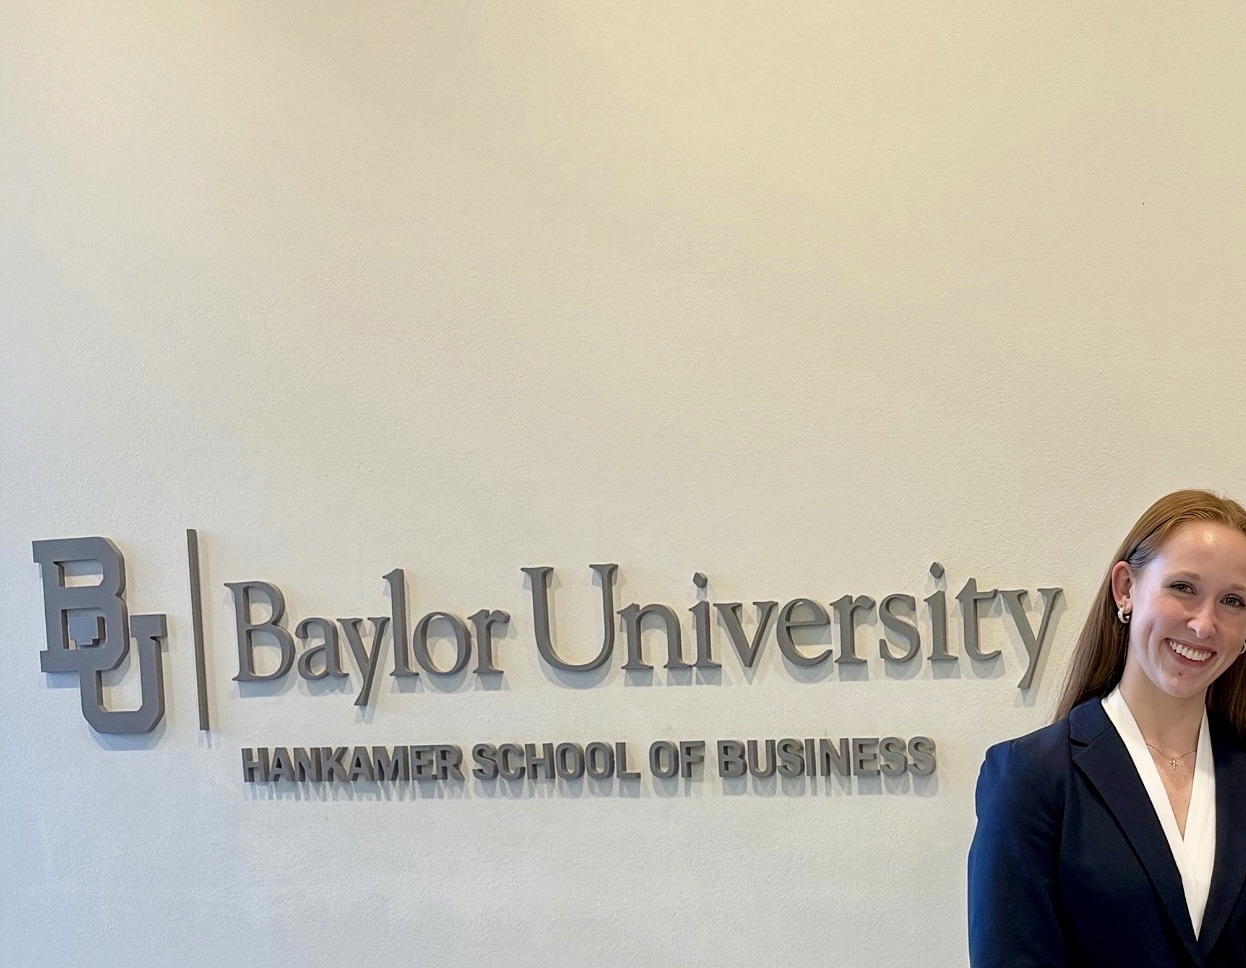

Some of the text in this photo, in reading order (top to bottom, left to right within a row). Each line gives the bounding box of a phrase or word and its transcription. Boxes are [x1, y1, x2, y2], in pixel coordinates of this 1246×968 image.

[32, 536, 168, 734] BU
[224, 561, 1064, 706] Baylor University
[241, 736, 938, 783] HANKAMER SCHOOL OF BUSINESS
